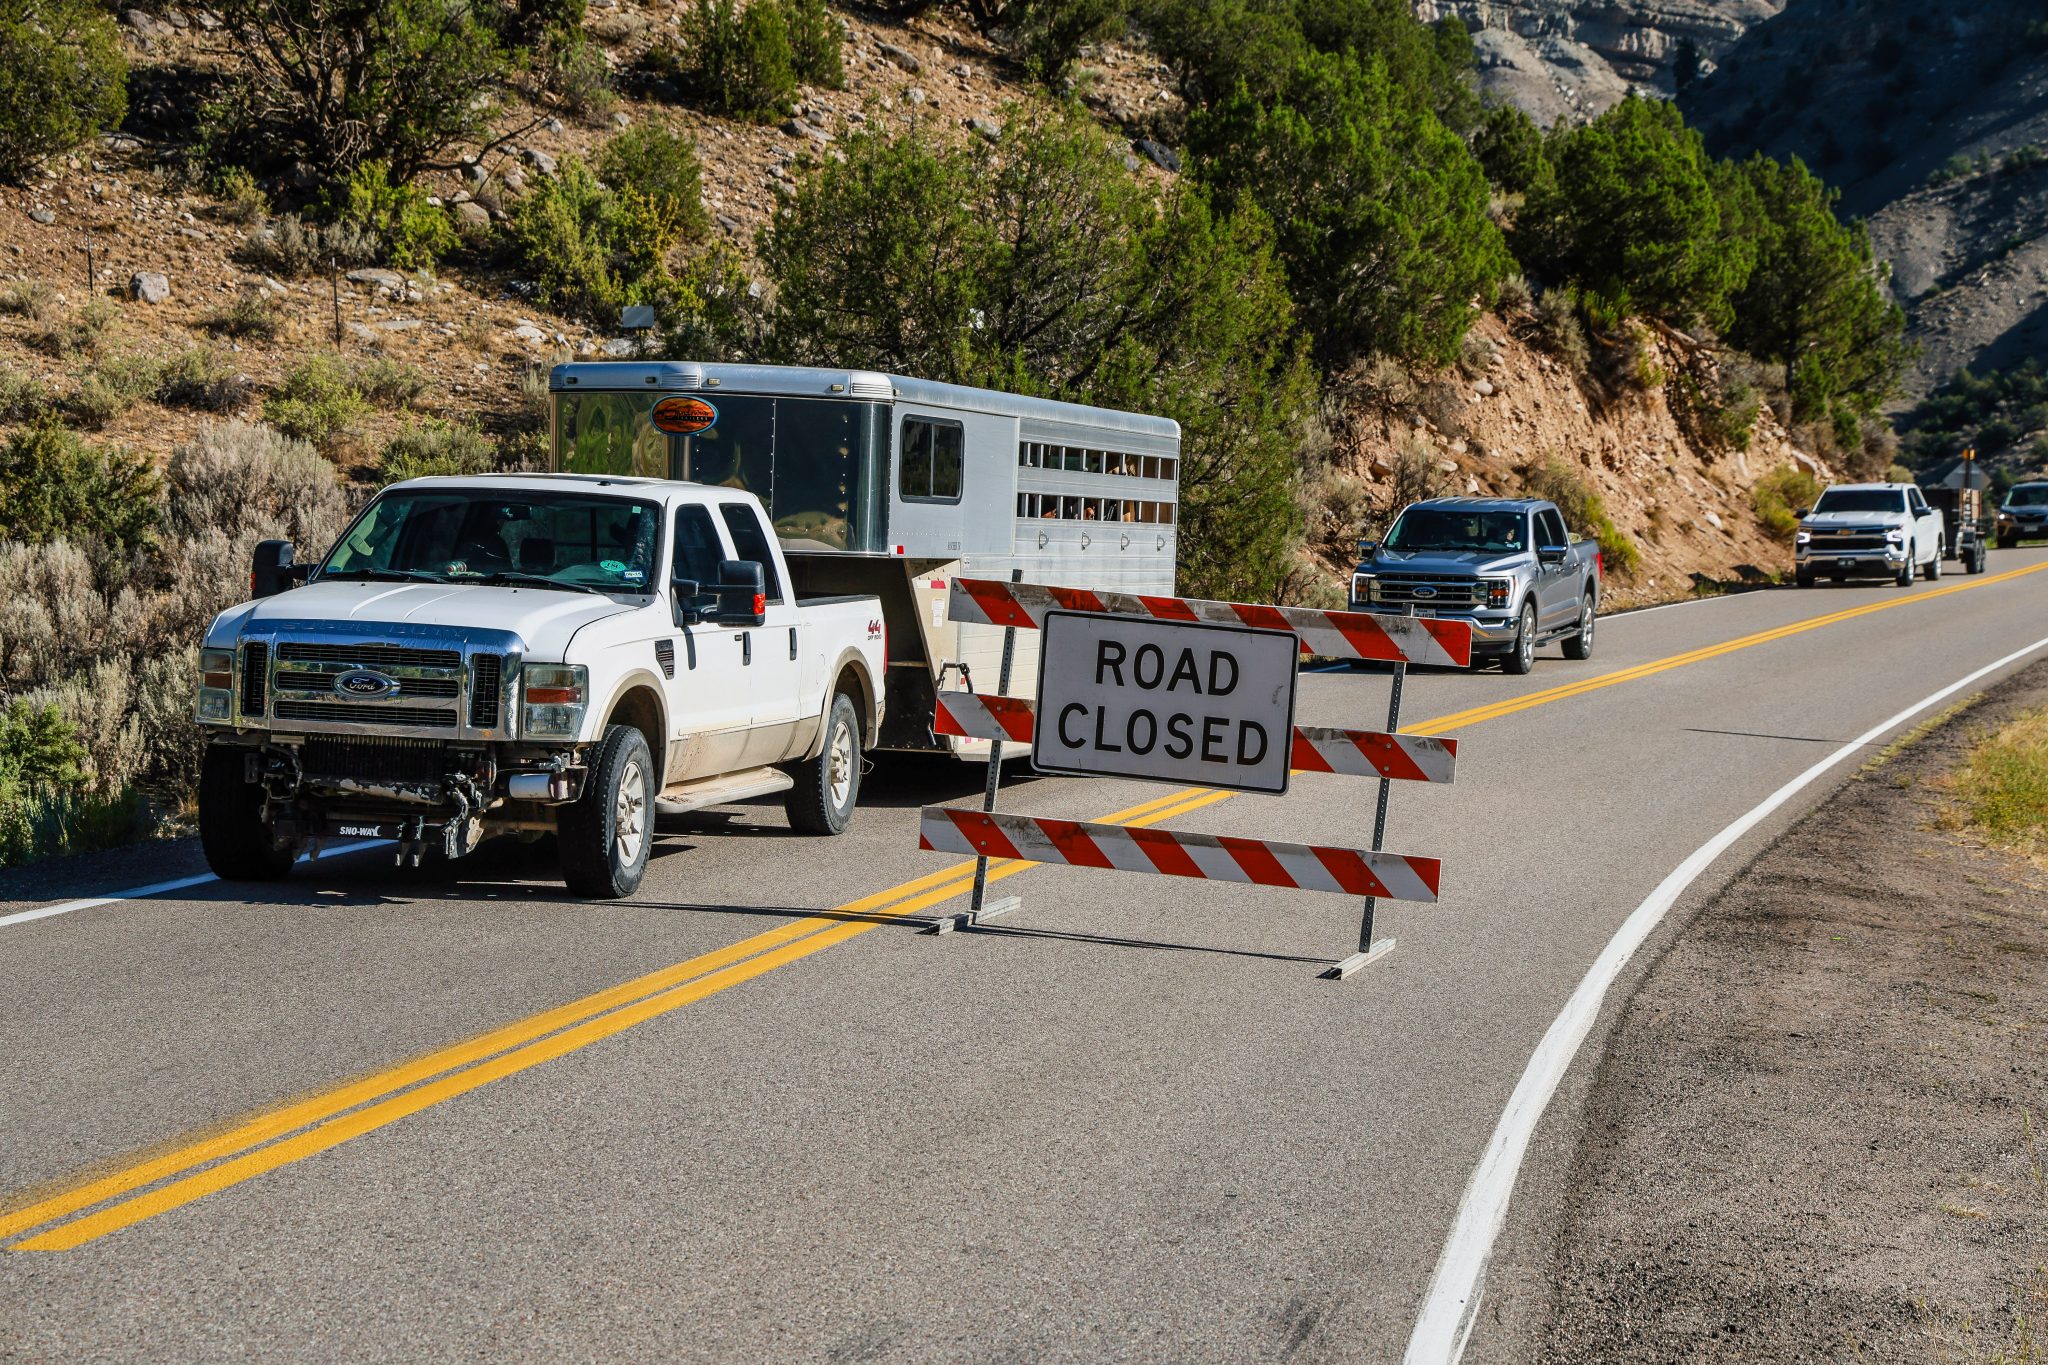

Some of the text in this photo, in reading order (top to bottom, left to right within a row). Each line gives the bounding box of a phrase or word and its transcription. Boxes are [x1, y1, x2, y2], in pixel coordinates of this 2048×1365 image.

[350, 677, 376, 690] Ford
[1095, 639, 1240, 696] ROAD
[1058, 702, 1268, 766] CLOSED
